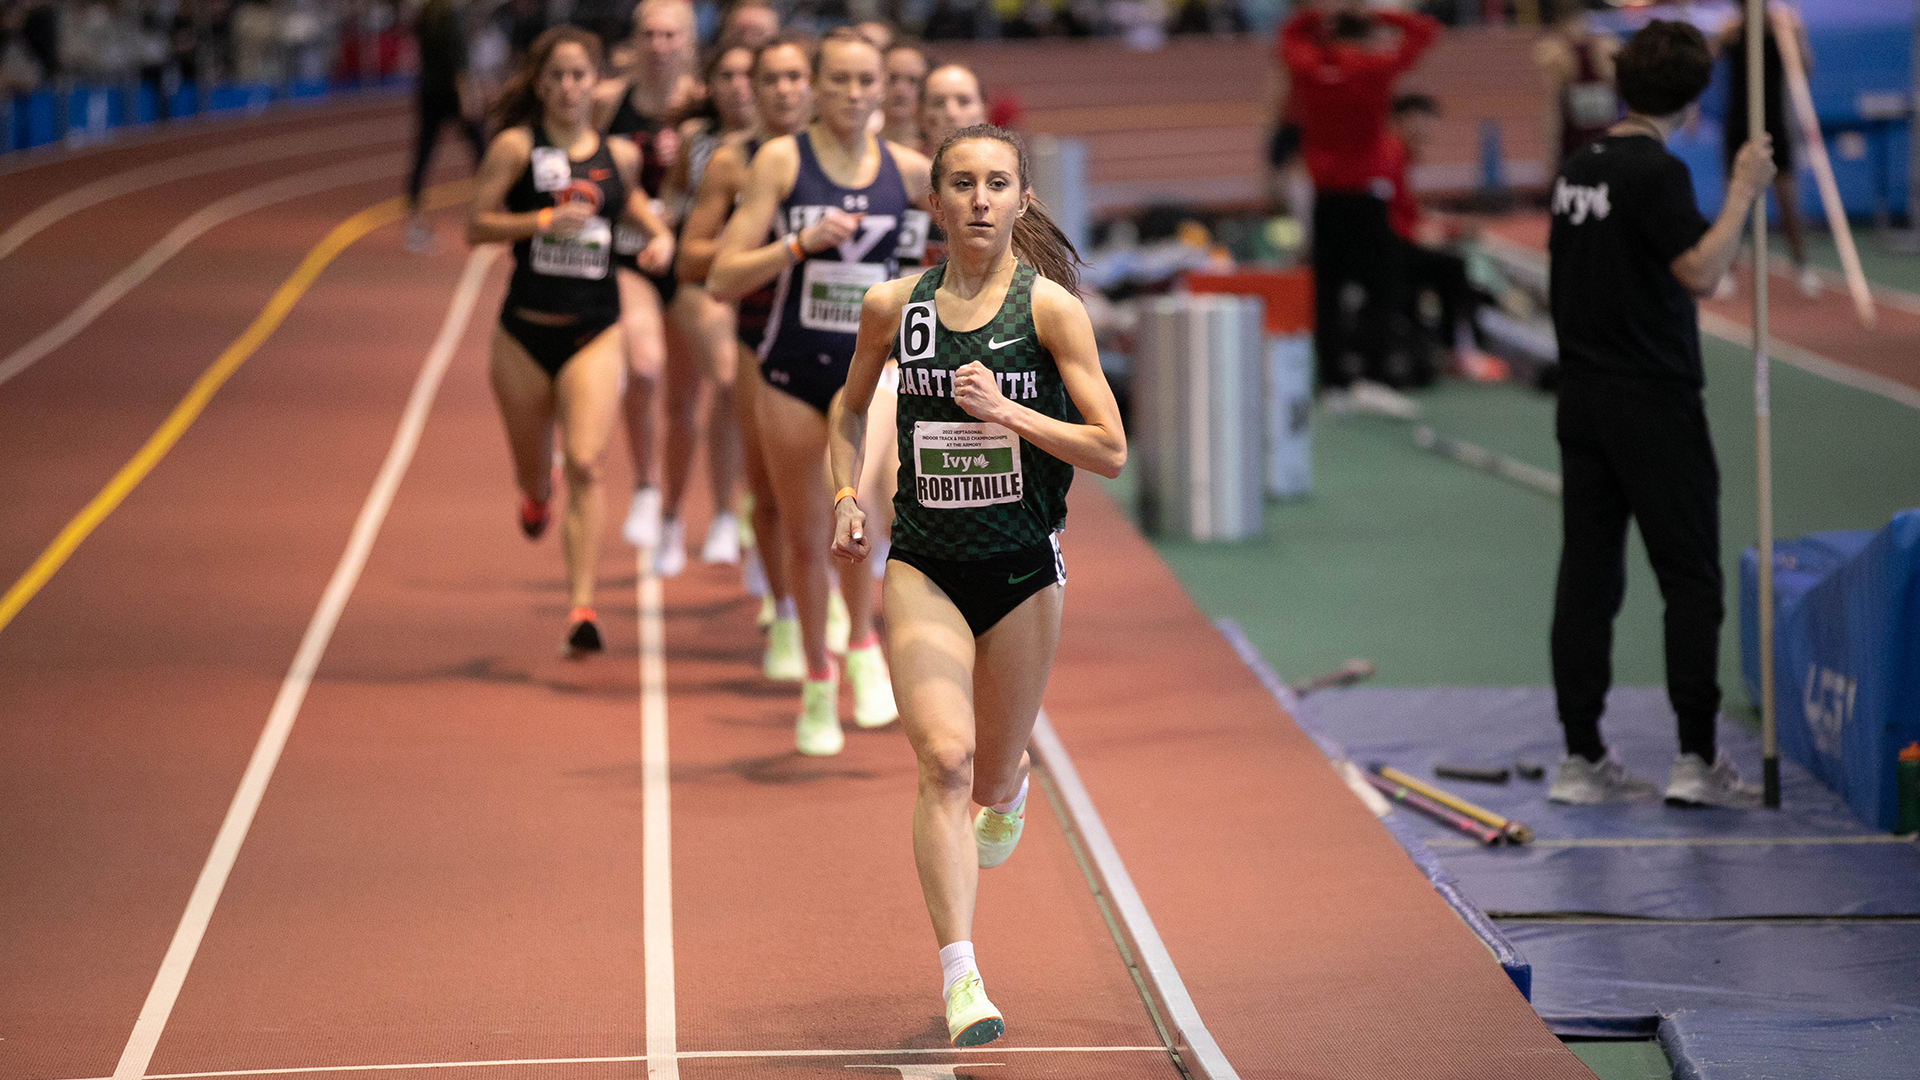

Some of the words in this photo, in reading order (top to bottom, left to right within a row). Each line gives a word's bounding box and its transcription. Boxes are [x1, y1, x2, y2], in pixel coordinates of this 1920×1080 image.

[904, 306, 930, 356] 6
[898, 367, 1038, 399] DARTTH
[942, 452, 972, 472] Ivy
[917, 473, 1021, 502] ROBITAILLE
